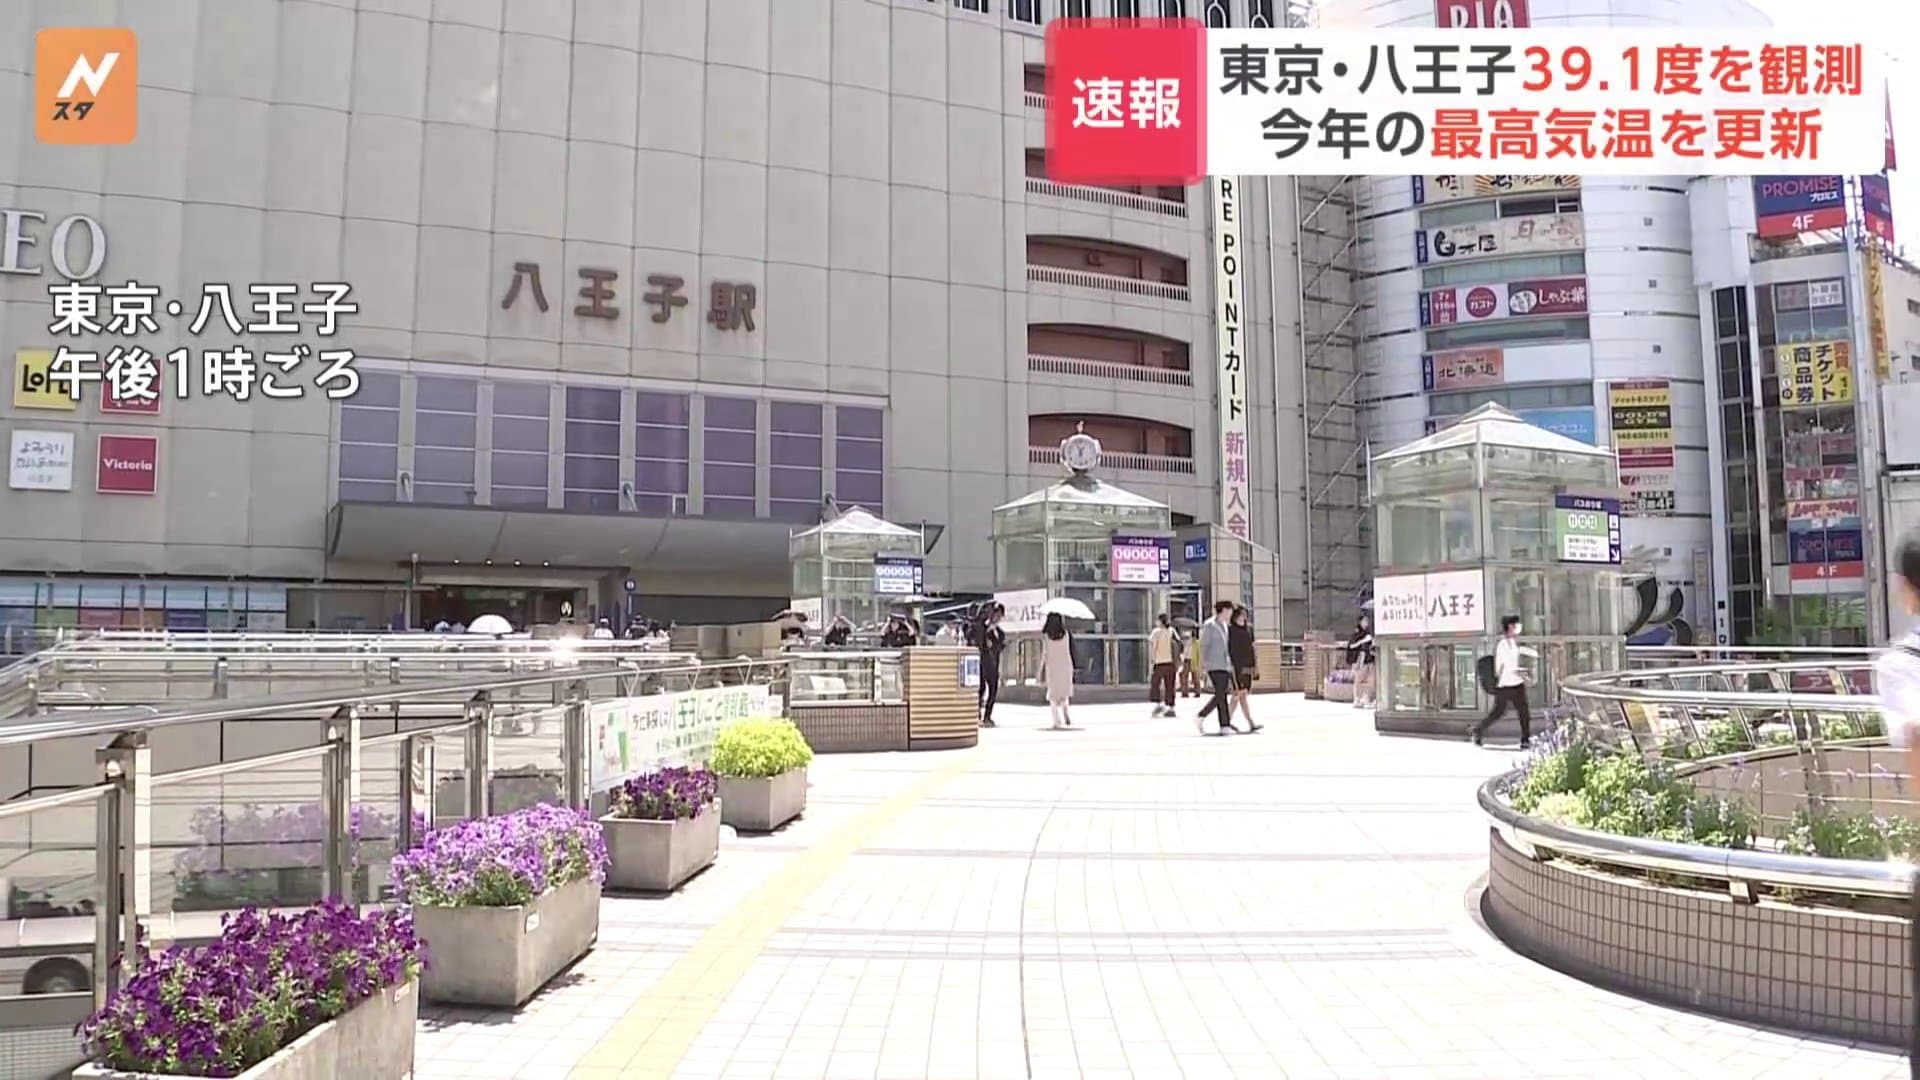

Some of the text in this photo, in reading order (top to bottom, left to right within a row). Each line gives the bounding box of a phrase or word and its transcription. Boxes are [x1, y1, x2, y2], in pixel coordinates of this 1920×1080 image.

[1762, 175, 1840, 199] PROMISE
[1792, 213, 1815, 231] 4F
[501, 261, 757, 333] 八王子駅
[1794, 346, 1814, 402] 商品券
[1816, 343, 1836, 401] チケット
[103, 457, 152, 471] Victoria
[1428, 593, 1475, 618] 八王子
